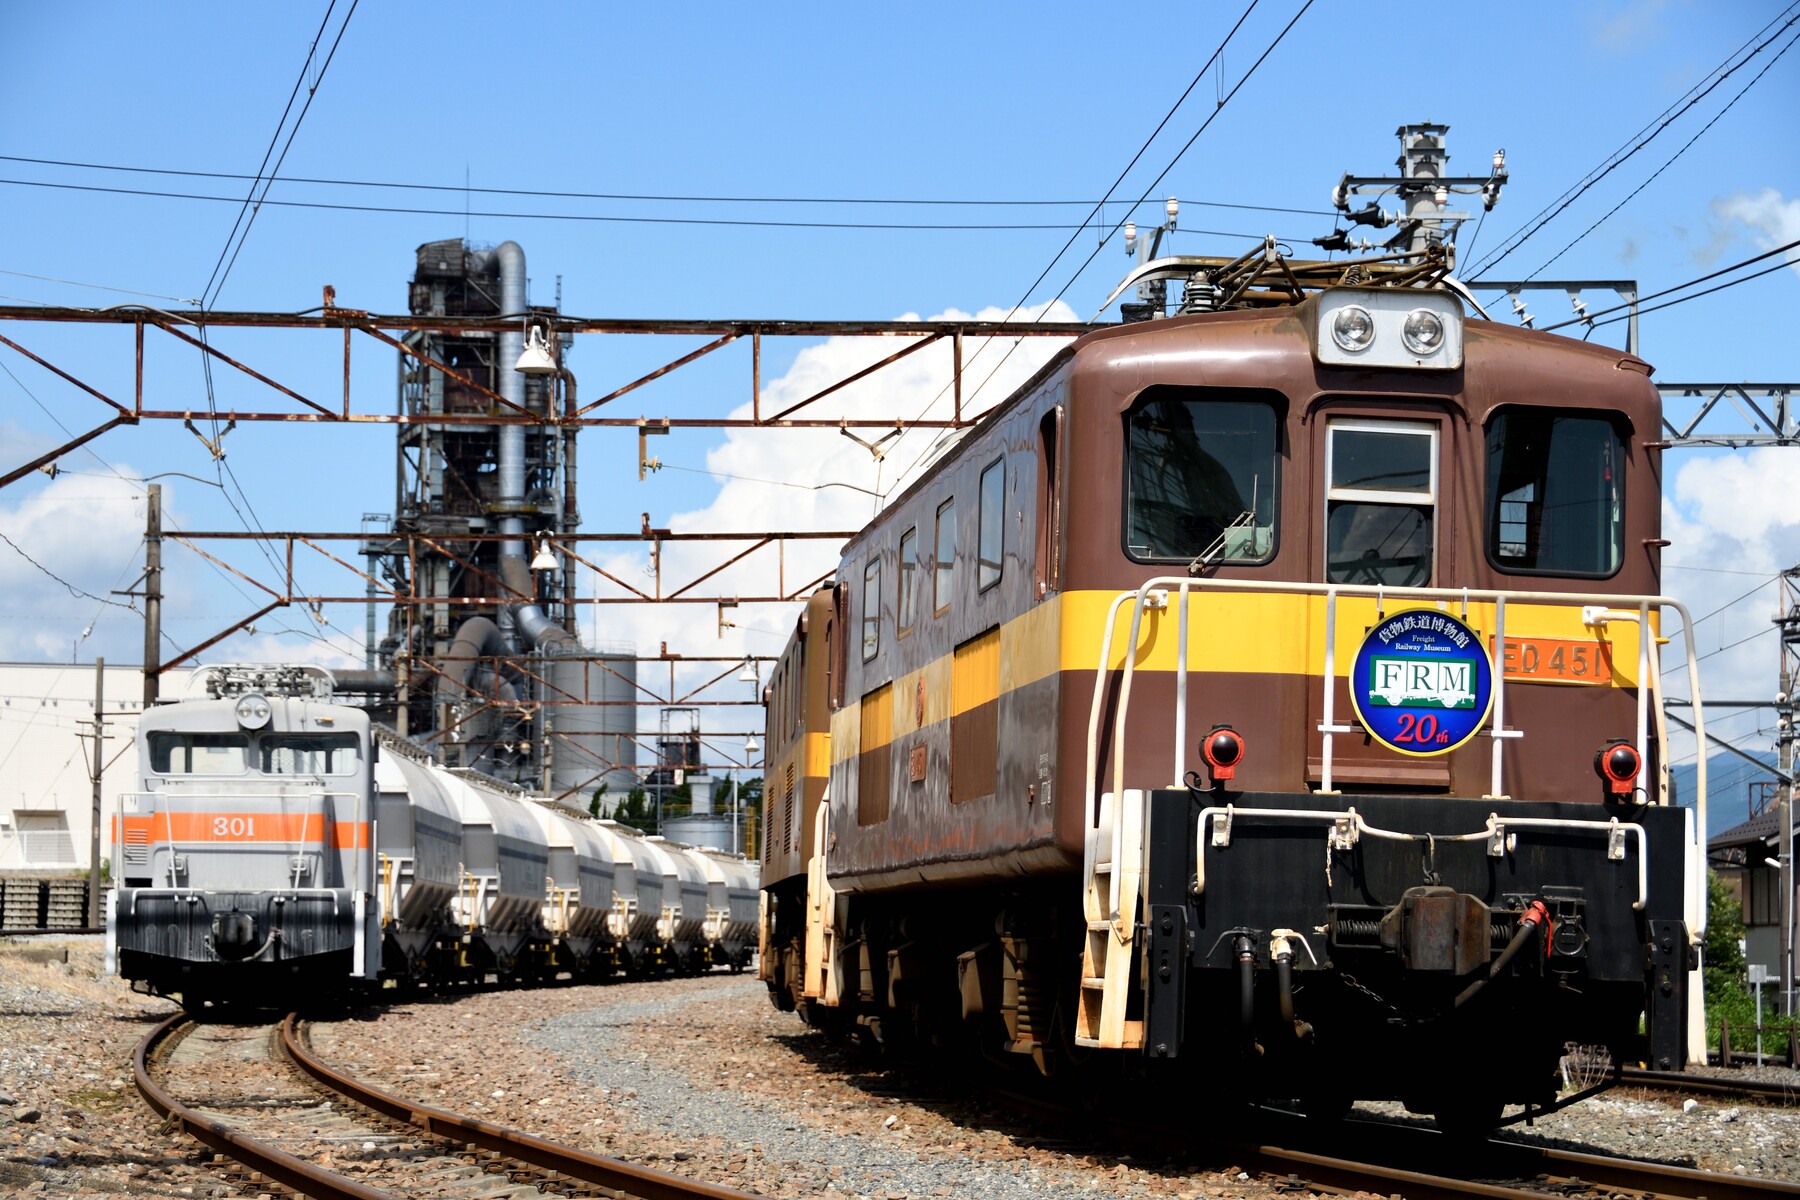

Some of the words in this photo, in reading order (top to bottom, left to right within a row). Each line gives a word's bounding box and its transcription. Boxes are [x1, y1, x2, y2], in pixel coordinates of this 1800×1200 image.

[1378, 615, 1470, 649] 貨物鉄道博物館
[1412, 635, 1435, 643] Freight
[1395, 643, 1421, 651] Railway
[1423, 644, 1451, 652] Museum
[1503, 643, 1539, 673] ED
[1548, 646, 1600, 676] 451
[1380, 663, 1467, 692] FRM
[213, 817, 255, 837] 301
